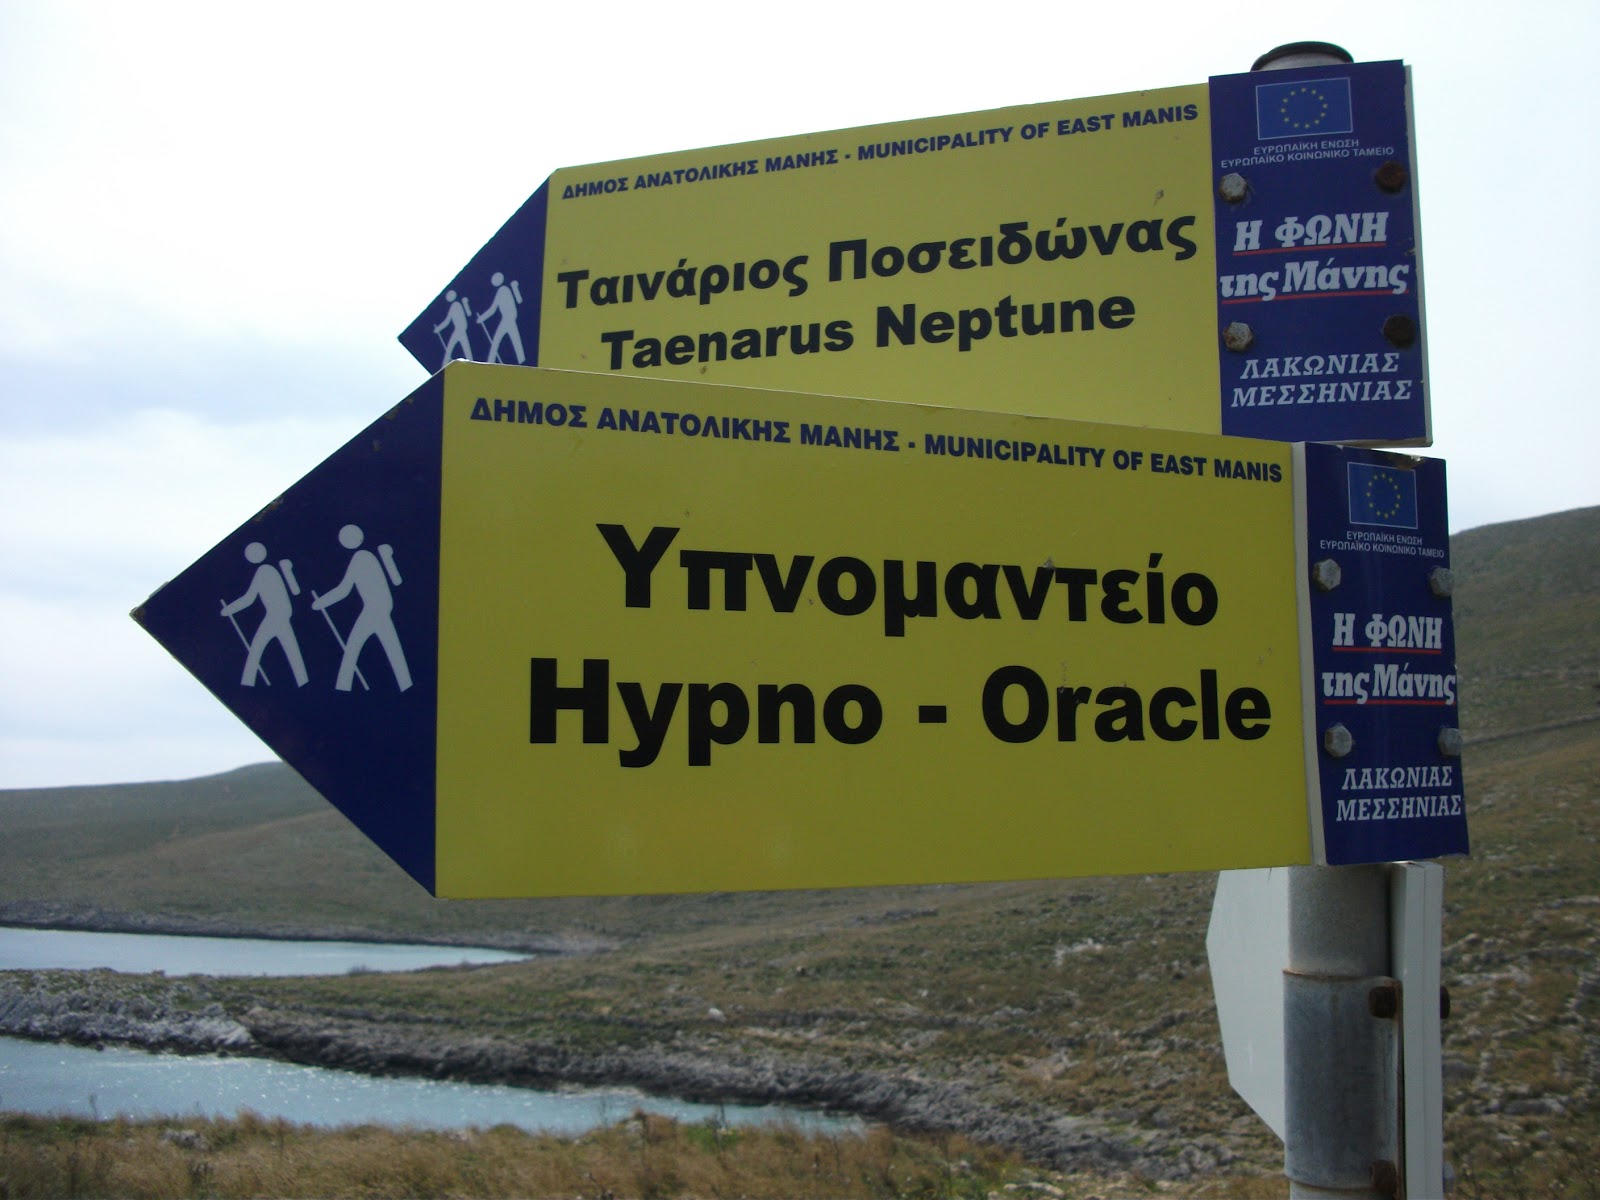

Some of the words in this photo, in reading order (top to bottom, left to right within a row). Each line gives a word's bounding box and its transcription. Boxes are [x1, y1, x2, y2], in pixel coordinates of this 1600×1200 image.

[562, 177, 629, 199] ΔΗΜΟΣ
[634, 160, 759, 189] ΑΝΑΤΟΛΙΚΗΣ
[765, 149, 838, 172] ΜΑΝΗΣ
[858, 127, 1013, 160] MUNICIPALITY
[1021, 122, 1050, 140] OF
[1057, 114, 1114, 136] EAST
[1123, 104, 1198, 128] MANIS
[1254, 142, 1318, 155] ΕΥΡΩΠΑΪΚΗ
[1321, 139, 1359, 149] ΕΝΩΣΗ
[1288, 149, 1350, 161] ΚΟΙΝΩΝΙΚΟ
[1353, 147, 1394, 157] ΤΑΜΕΙΟ
[1233, 220, 1262, 252] Η
[1275, 212, 1389, 248] ΦΩΝΗ
[557, 255, 809, 309] Ταινάριος
[828, 215, 1197, 282] Ποσειδώνας
[1220, 271, 1279, 301] της
[1282, 258, 1409, 294] Μάνης
[601, 320, 854, 370] Taenarus
[876, 295, 1136, 352] Neptune
[1240, 353, 1399, 379] ΛΑΚΩΝΙΑΣ
[1231, 380, 1412, 408] ΜΕΣΣΗΝΙΑΣ
[470, 398, 588, 428] ΔΗΜΟΣ
[597, 407, 791, 444] ΑΝΑΤΟΛΙΚΗΣ
[799, 424, 900, 452] ΜΑΝΗΣ
[924, 434, 1105, 468] MUNICIPALITY
[1112, 450, 1143, 471] OF
[1151, 453, 1207, 476] EAST
[1214, 458, 1283, 483] MANIS
[1373, 543, 1416, 555] ΚΟΙΝΩΝΙΚΟ
[1418, 547, 1444, 558] ΤΑΜΕΙΟ
[1397, 535, 1422, 545] ΕΝΩΣΗ
[596, 522, 1219, 638] Υπνομαντείο
[1332, 613, 1355, 646] Η
[1365, 614, 1442, 649] ΦΩΝΗ
[1322, 672, 1370, 704] της
[1372, 663, 1456, 705] Μάνης
[530, 657, 883, 768] Hypno
[981, 664, 1271, 744] Oracle
[1341, 766, 1452, 790] ΛΑΚΩΝΙΑΣ
[1336, 795, 1461, 821] ΜΕΣΣΗΝΙΑΣ
